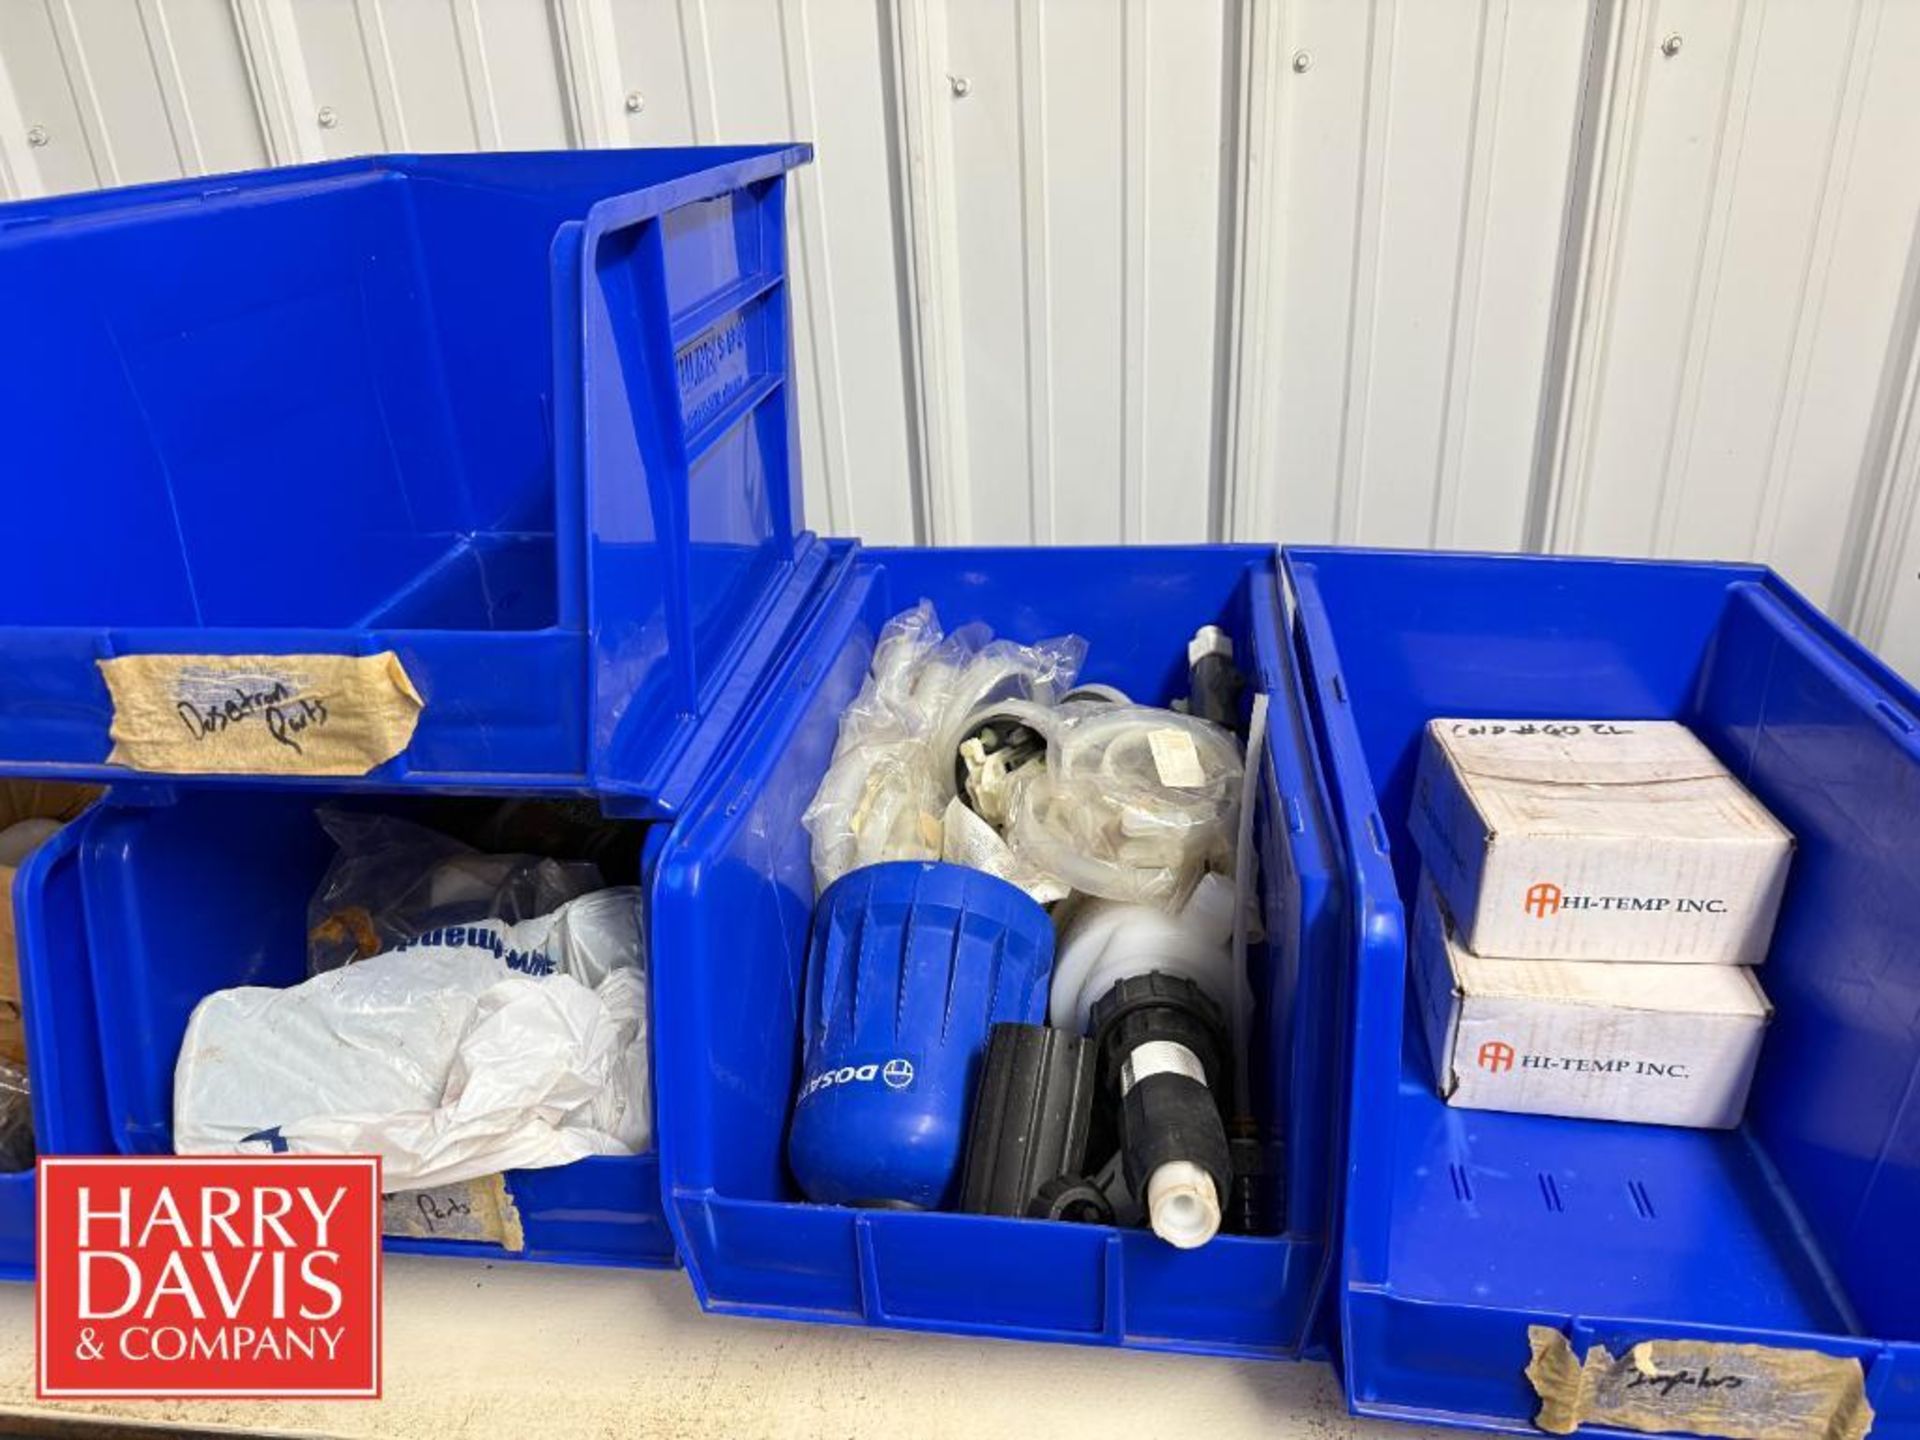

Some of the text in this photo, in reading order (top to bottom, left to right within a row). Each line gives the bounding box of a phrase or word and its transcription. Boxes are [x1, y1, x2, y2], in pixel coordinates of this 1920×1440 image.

[266, 699, 328, 755] Parts
[1561, 896, 1728, 913] HI-TEMP INC.
[1521, 1054, 1690, 1079] HI-TEMP INC.
[417, 1193, 471, 1232] Parts
